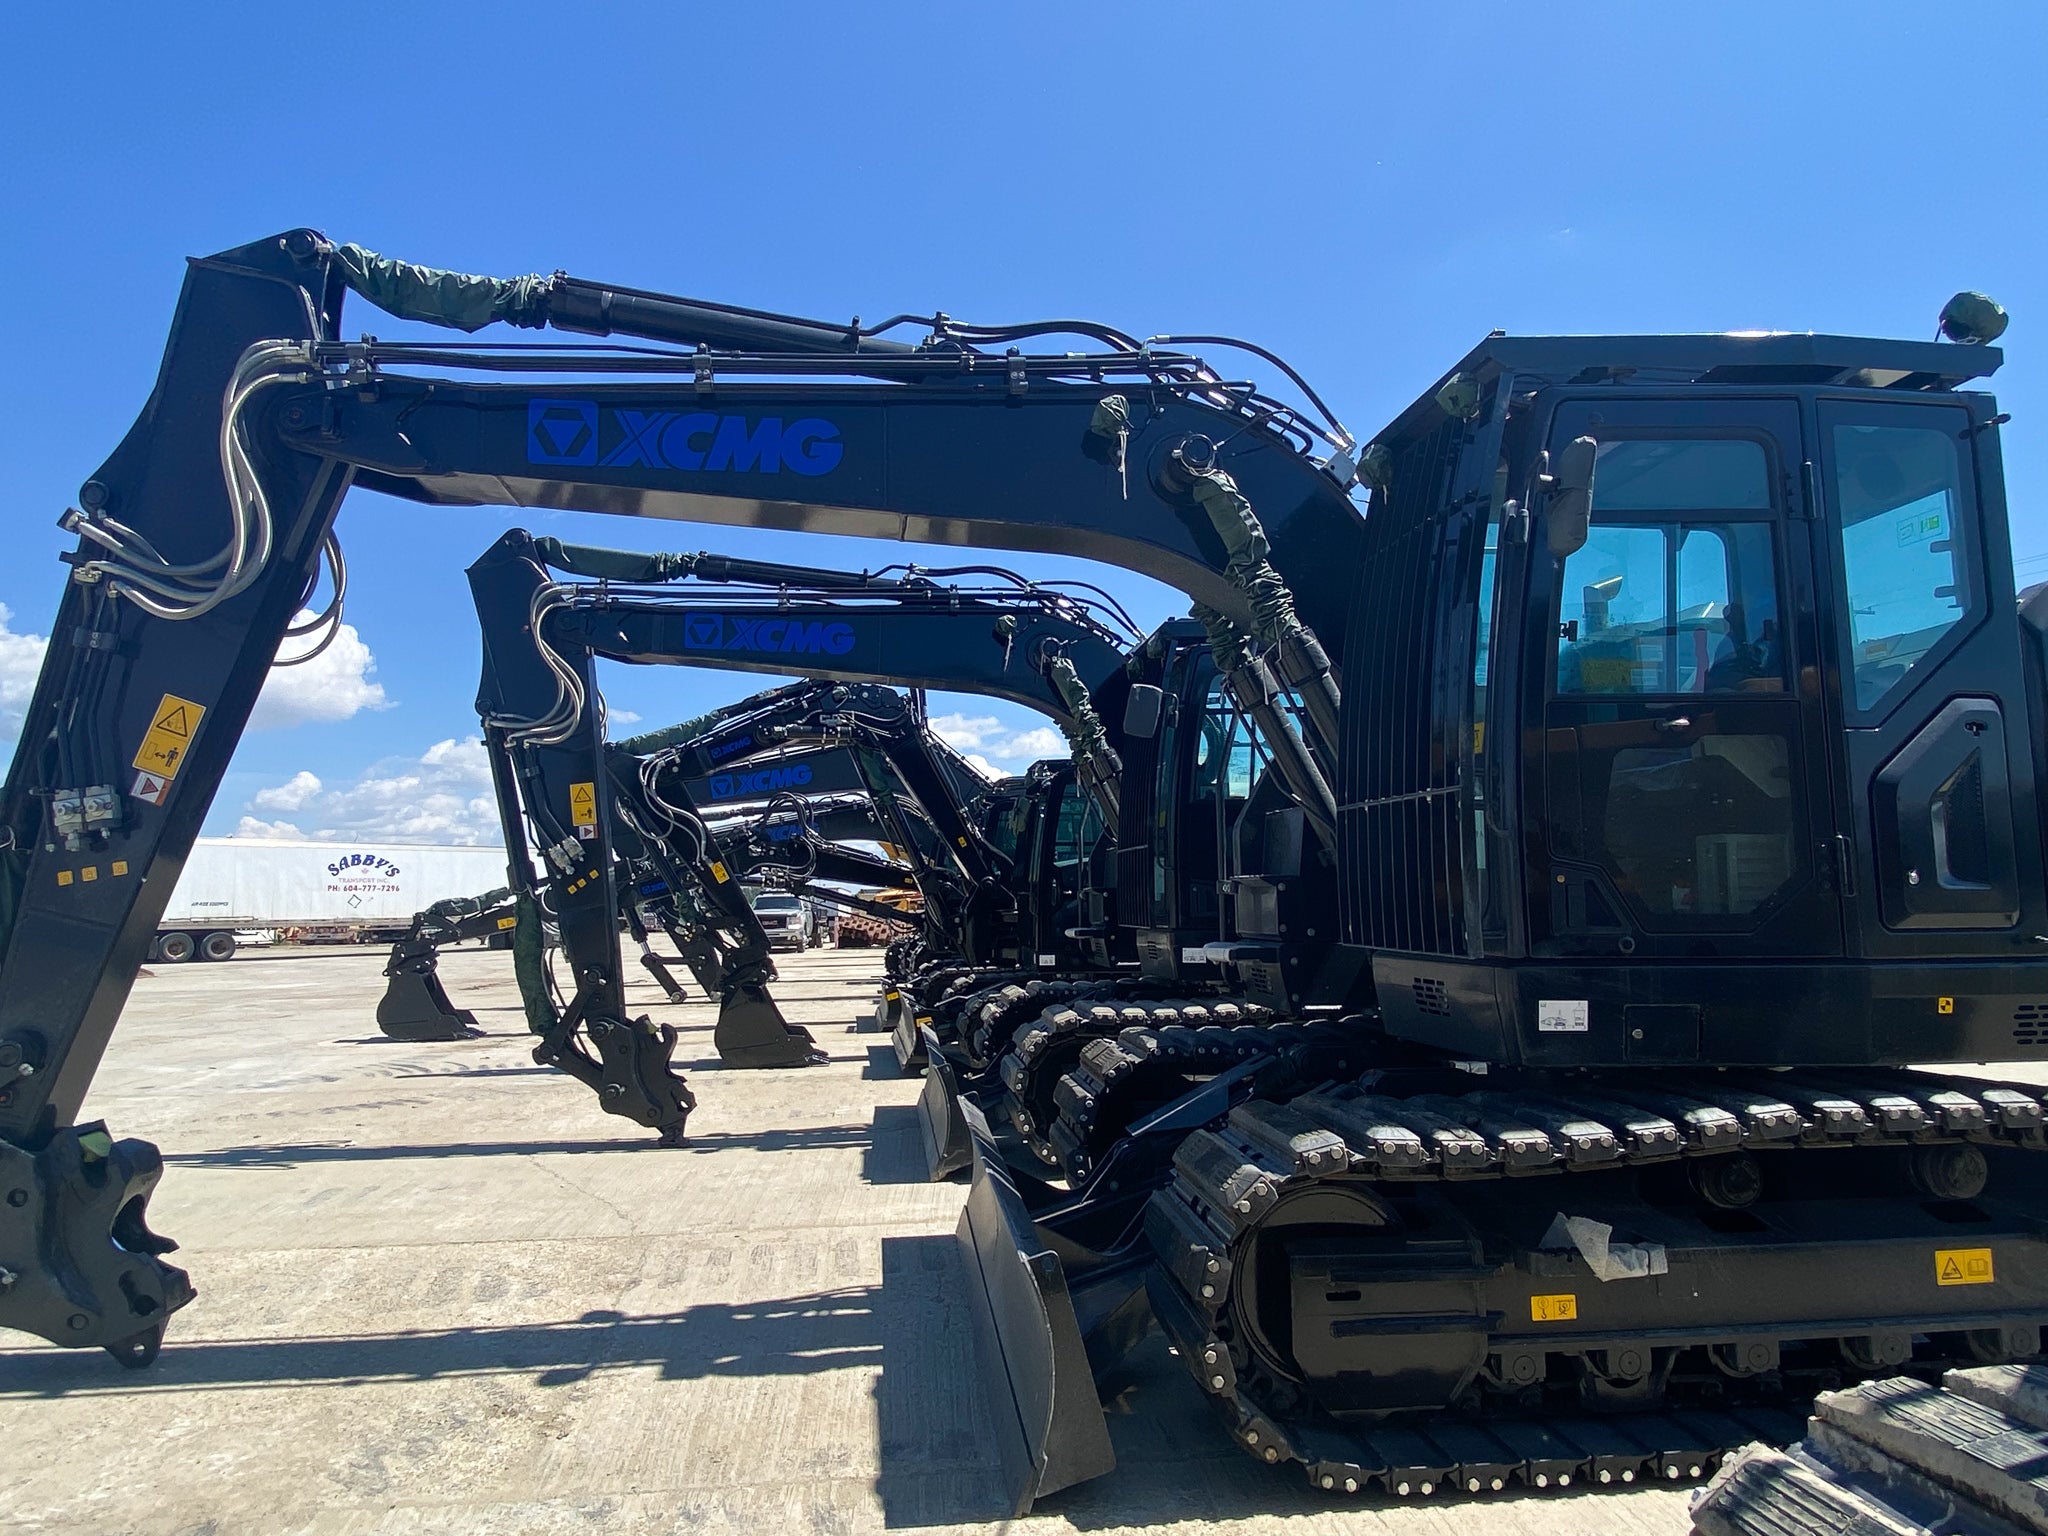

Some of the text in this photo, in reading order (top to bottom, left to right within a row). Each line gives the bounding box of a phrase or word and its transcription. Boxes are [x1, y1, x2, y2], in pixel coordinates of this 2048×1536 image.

[599, 410, 843, 476] XCMG
[726, 619, 855, 654] XCMG
[736, 764, 812, 795] XCMG
[328, 854, 400, 876] SABBY'S
